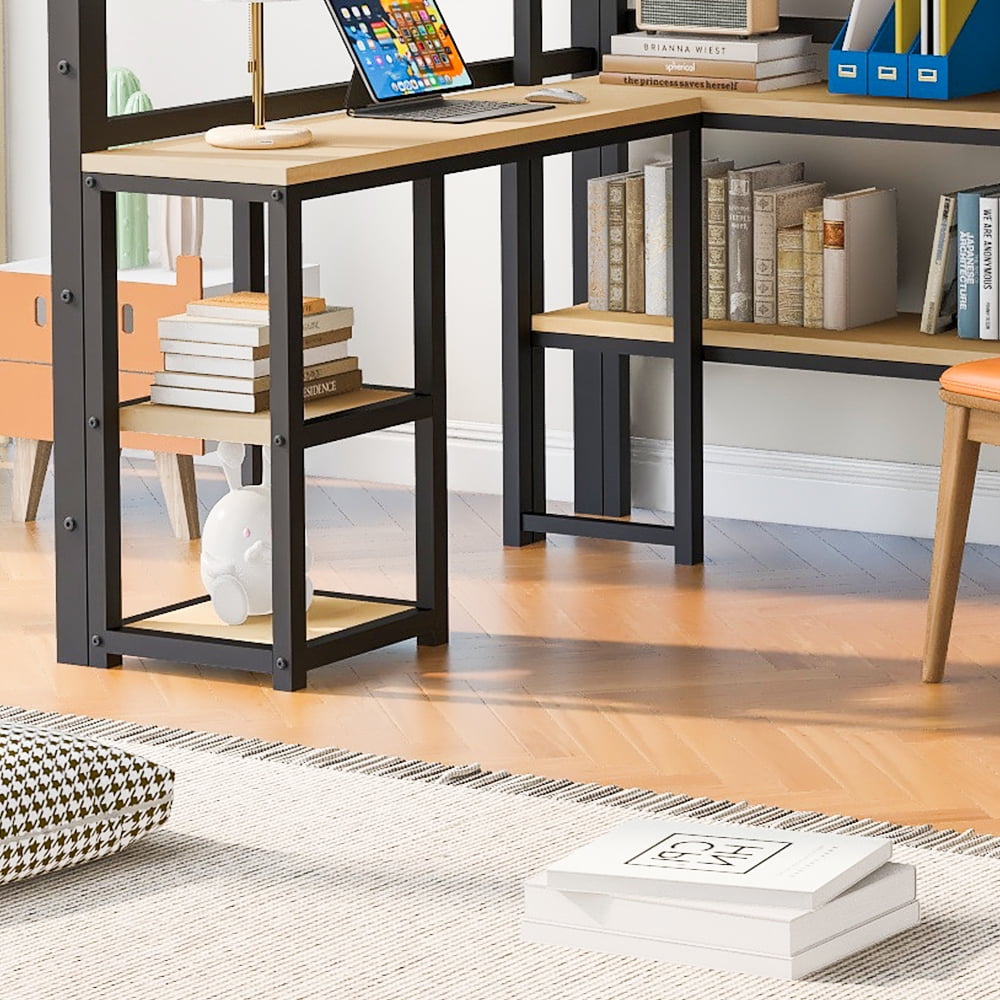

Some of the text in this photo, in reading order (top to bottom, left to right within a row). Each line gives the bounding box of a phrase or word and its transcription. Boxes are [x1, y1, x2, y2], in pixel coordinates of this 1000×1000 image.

[643, 43, 726, 55] BRIANNA WIEST
[959, 231, 968, 311] ARCHITECTURE
[966, 232, 975, 285] JAPANESE
[983, 208, 992, 290] WE ARE ANONYMOUS
